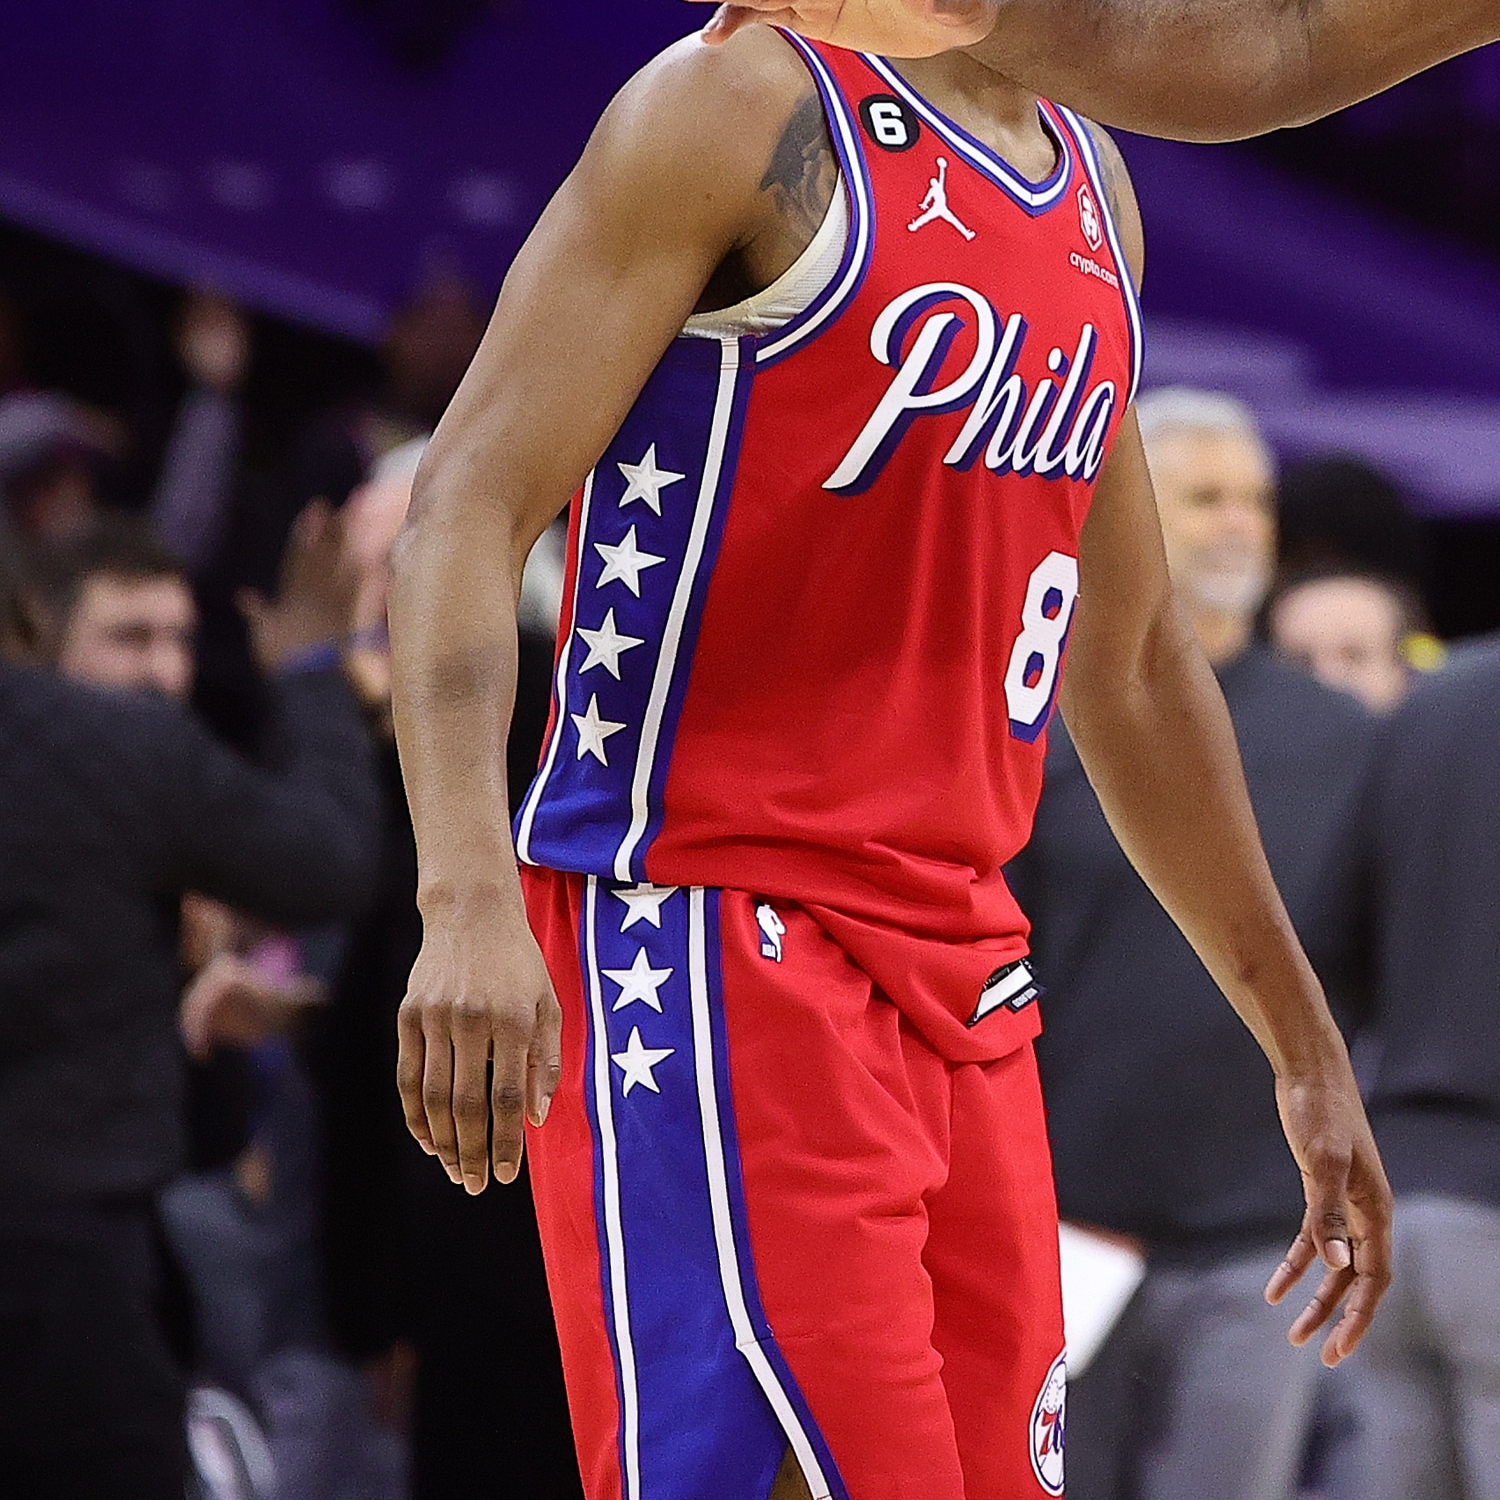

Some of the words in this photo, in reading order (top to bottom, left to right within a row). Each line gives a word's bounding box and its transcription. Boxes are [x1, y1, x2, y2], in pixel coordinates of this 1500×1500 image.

[868, 102, 908, 145] 6
[1069, 251, 1120, 290] crypto.com
[822, 282, 1116, 492] Phila
[1003, 550, 1080, 736] 8
